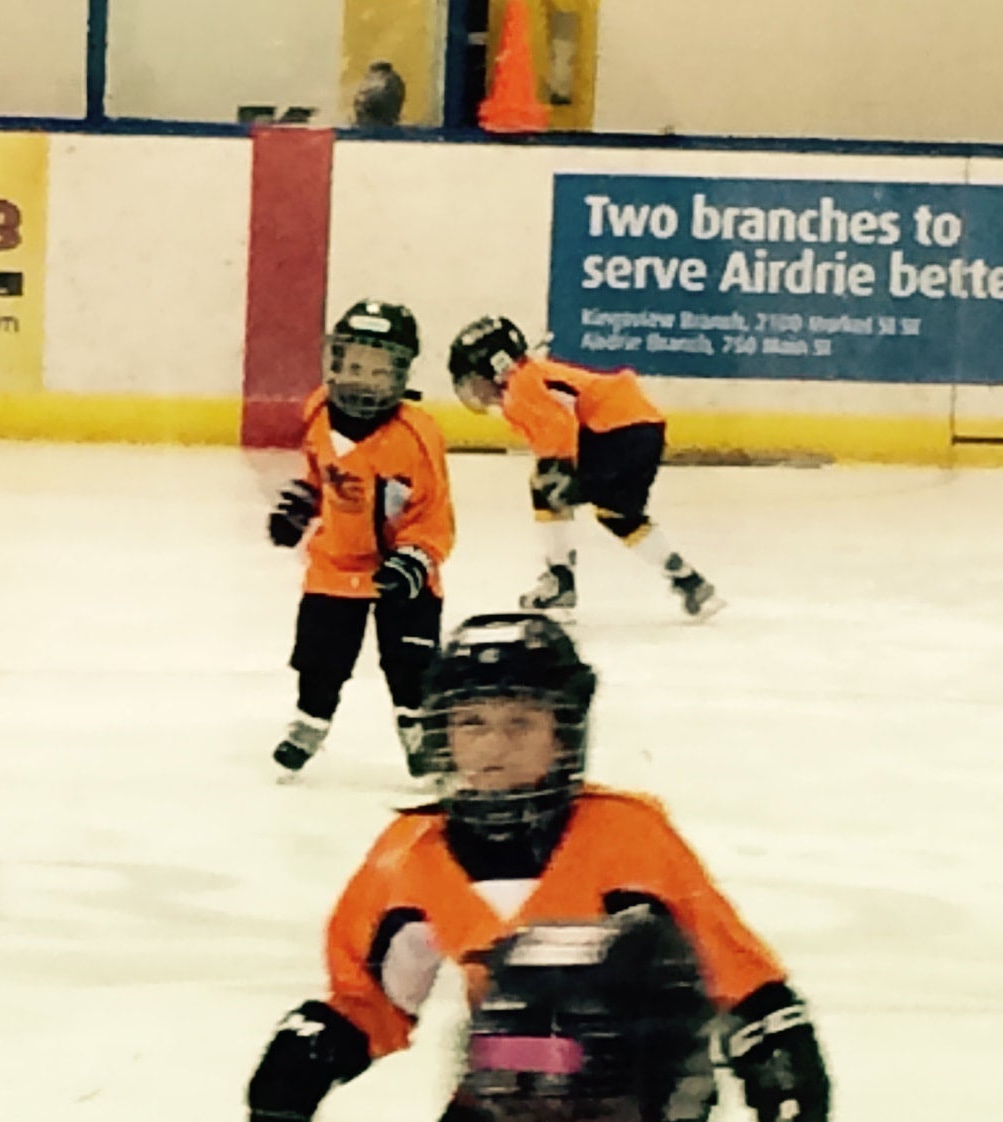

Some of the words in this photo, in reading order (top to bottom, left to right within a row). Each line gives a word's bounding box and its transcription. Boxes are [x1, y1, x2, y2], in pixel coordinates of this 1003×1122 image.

[584, 194, 679, 239] Two
[691, 193, 901, 246] branches
[913, 204, 962, 248] to
[581, 254, 707, 292] serve
[718, 248, 876, 295] Airdrie
